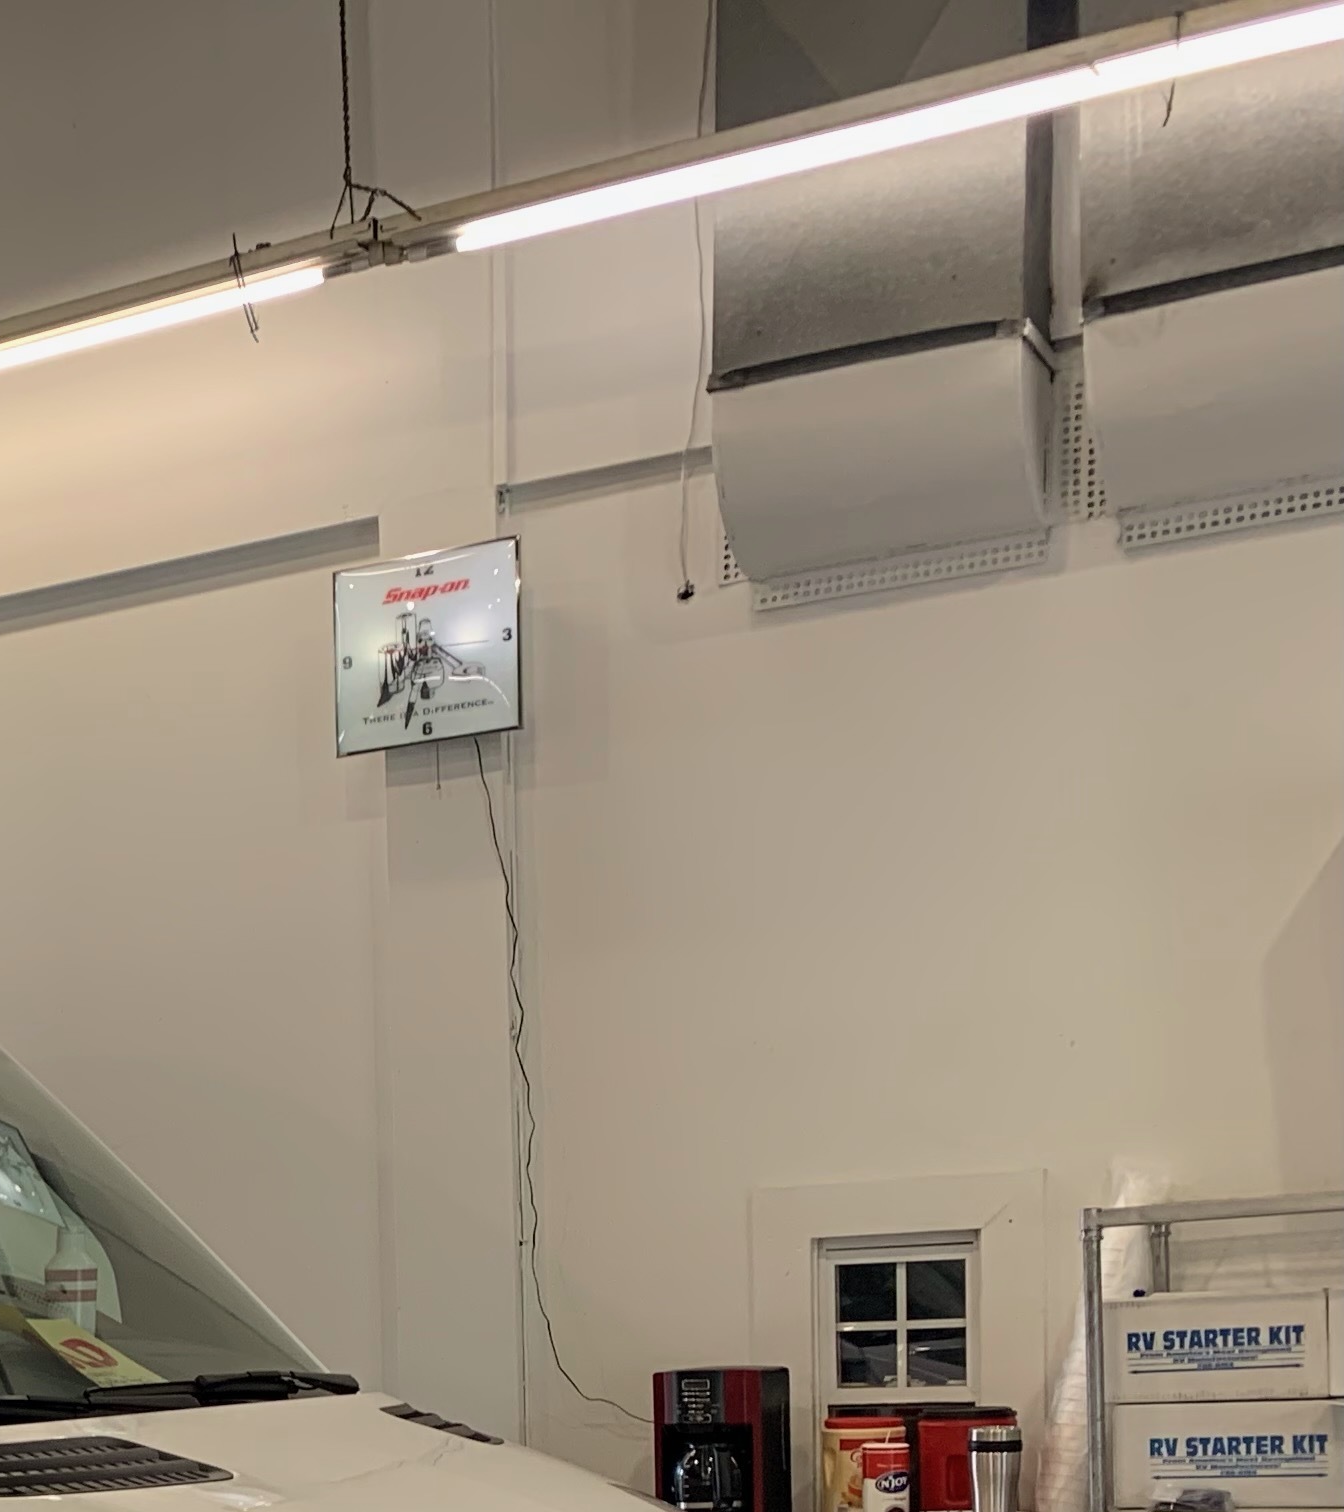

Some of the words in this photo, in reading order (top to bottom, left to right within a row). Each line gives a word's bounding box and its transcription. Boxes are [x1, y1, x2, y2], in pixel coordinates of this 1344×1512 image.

[382, 578, 470, 605] Snap-on
[502, 628, 513, 642] 3
[342, 656, 353, 670] 9
[362, 712, 396, 726] THERE
[422, 698, 489, 717] DIFFERENCE
[422, 722, 433, 735] 6
[1127, 1332, 1156, 1351] RV
[1163, 1327, 1261, 1350] STARTER
[1269, 1324, 1305, 1345] KIT
[1149, 1437, 1178, 1457] RV
[1186, 1435, 1285, 1456] STARTER
[1292, 1434, 1328, 1454] KIT
